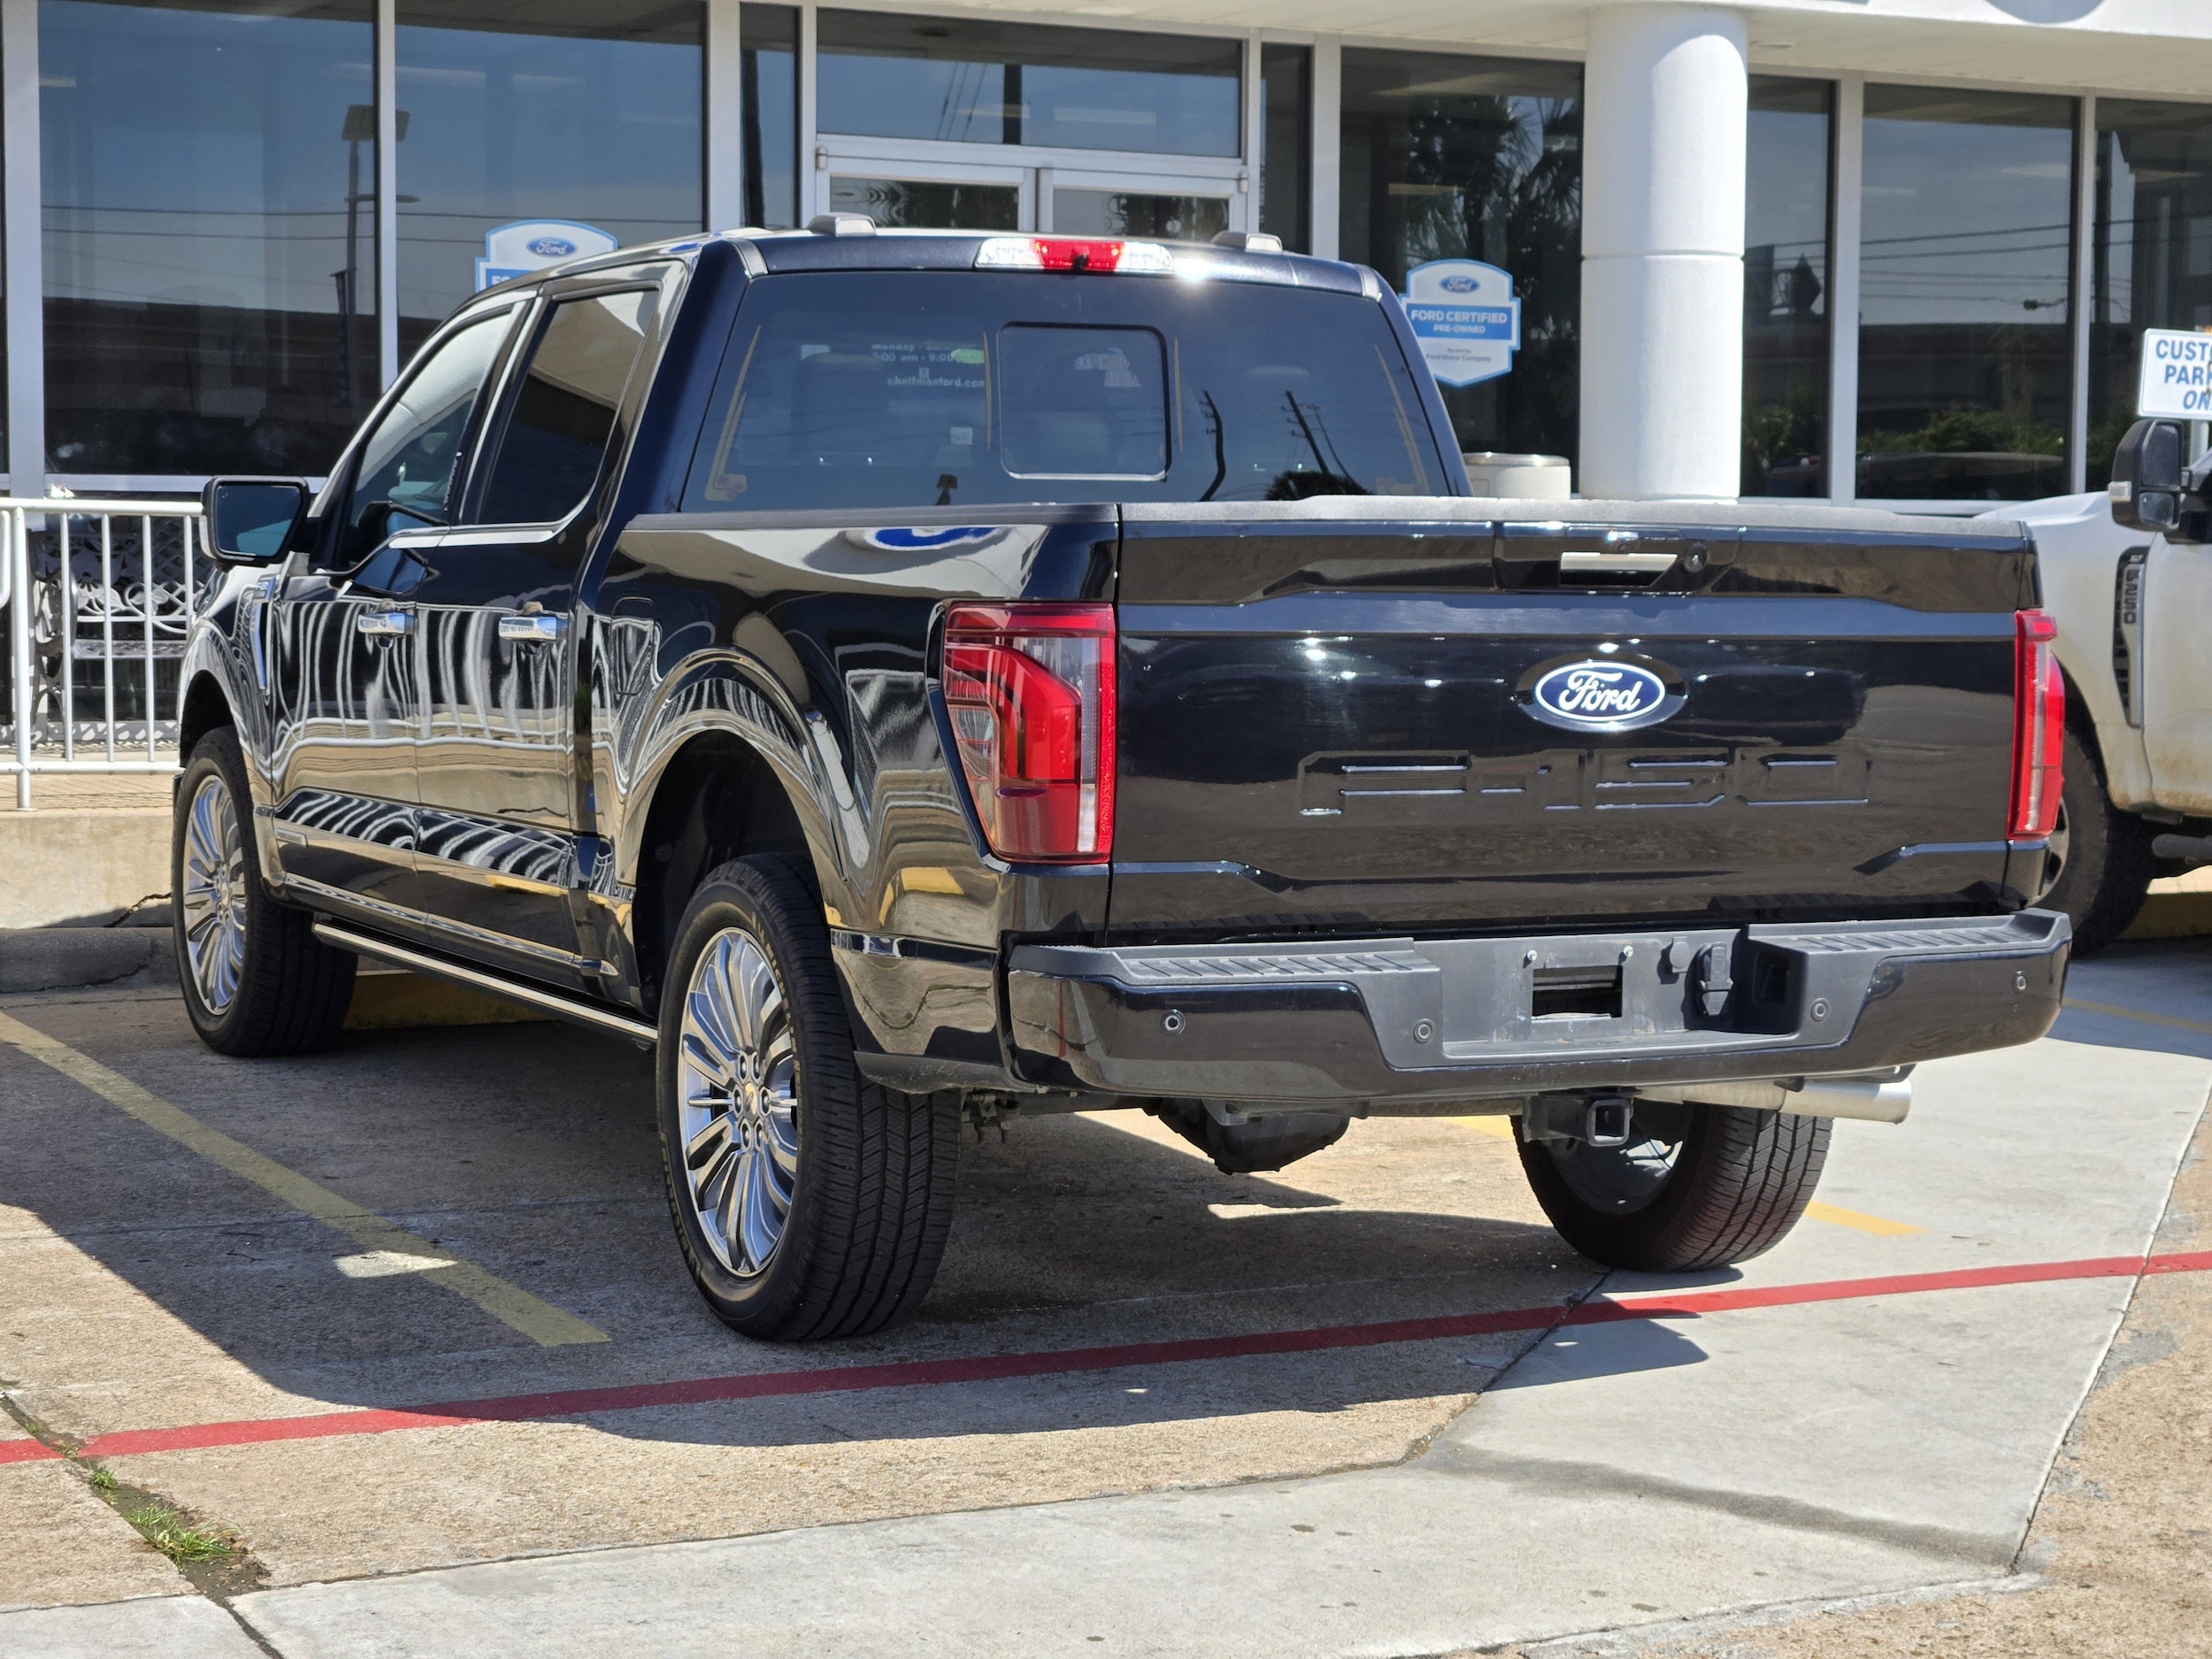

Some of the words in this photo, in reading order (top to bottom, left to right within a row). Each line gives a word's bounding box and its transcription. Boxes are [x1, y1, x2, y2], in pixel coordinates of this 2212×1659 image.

[536, 240, 566, 255] Ford
[1447, 278, 1472, 290] Ford
[1411, 310, 1444, 321] FORD
[1446, 311, 1509, 324] CERTIFIED
[1433, 324, 1486, 334] PRE-OWNED
[2155, 339, 2212, 361] CUST
[2183, 390, 2212, 411] ON
[1558, 670, 1643, 710] Ford
